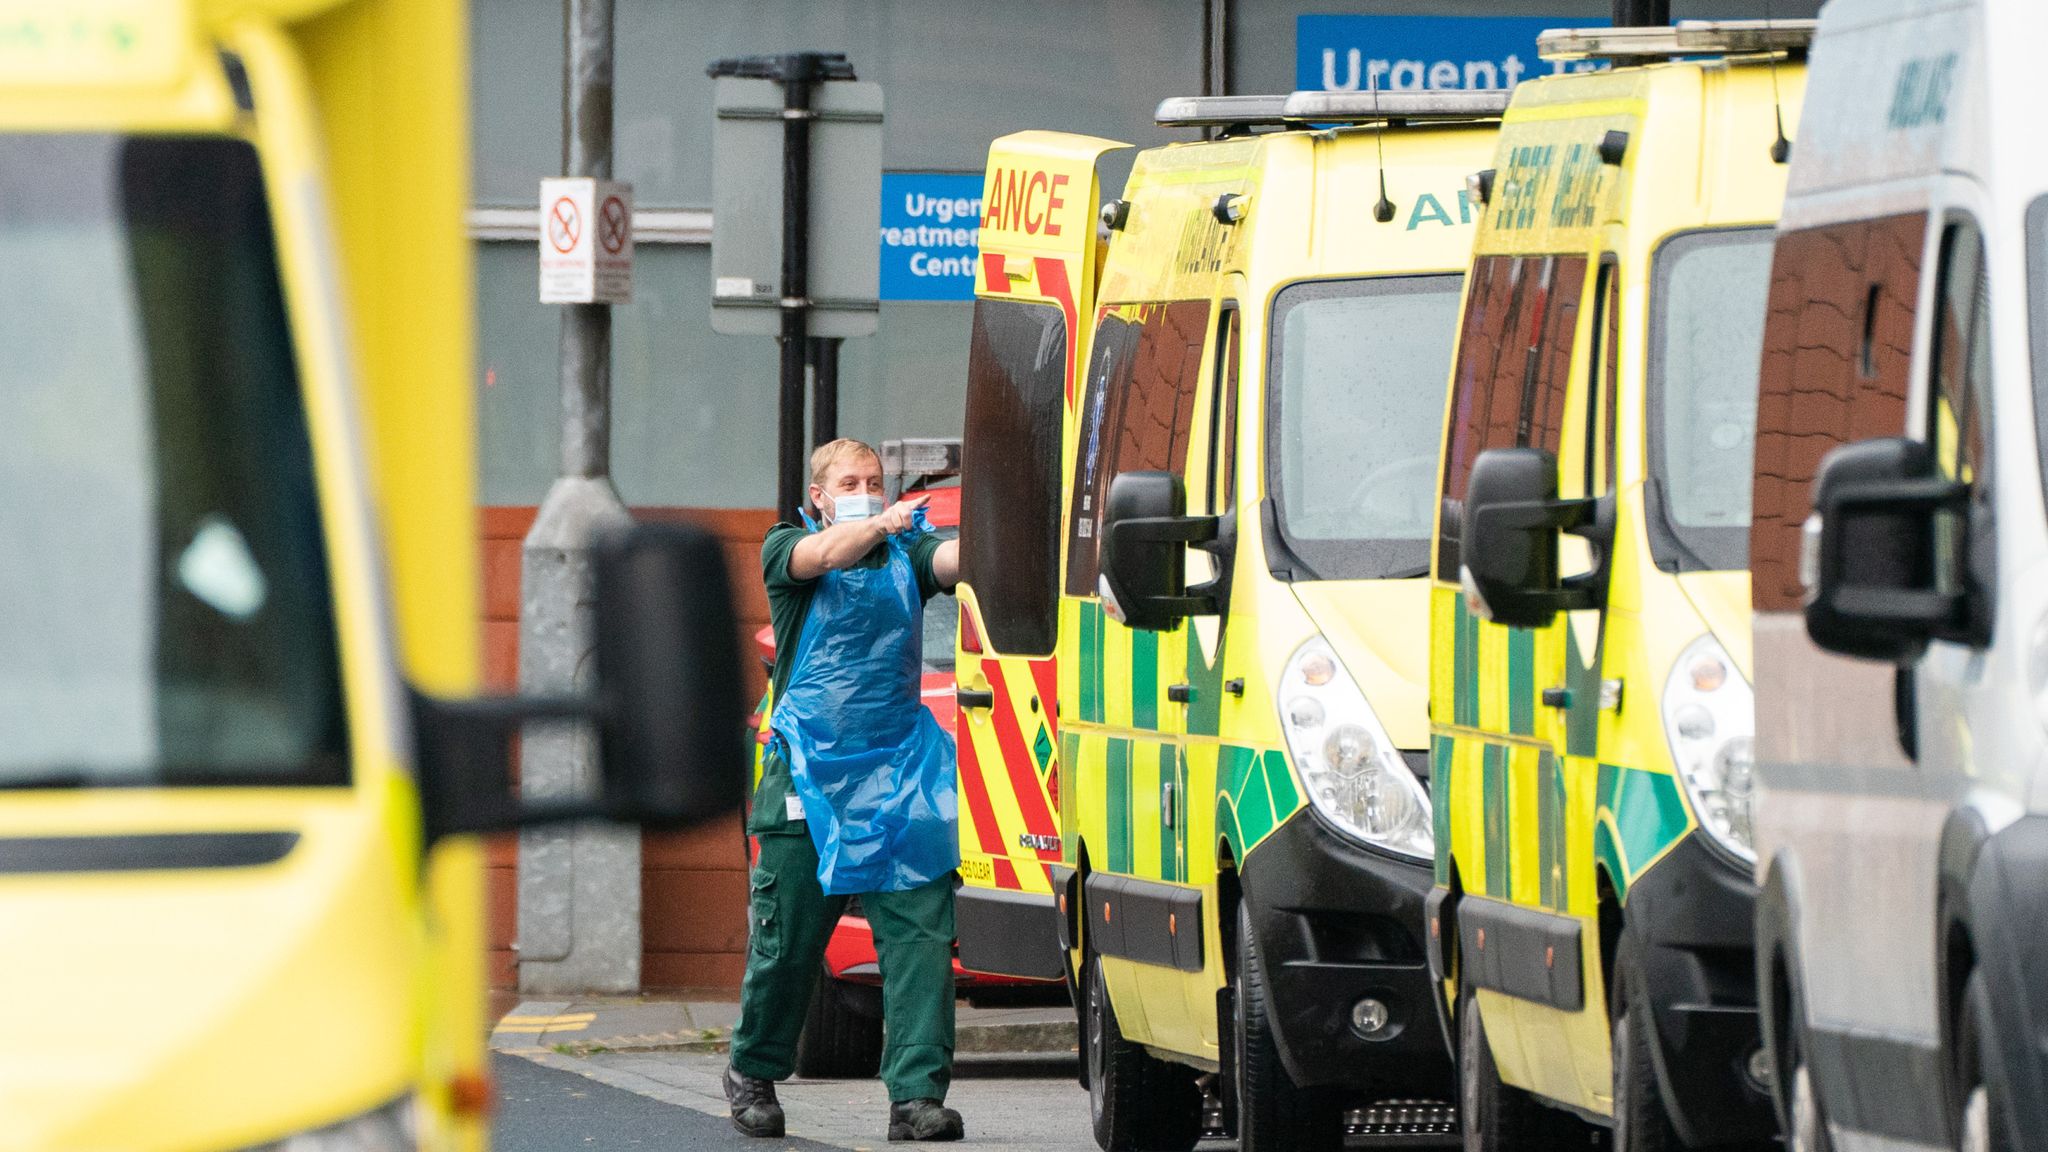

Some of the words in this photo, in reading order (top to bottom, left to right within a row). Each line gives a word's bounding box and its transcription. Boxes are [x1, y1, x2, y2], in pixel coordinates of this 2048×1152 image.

[1322, 47, 1525, 91] Urgent
[905, 192, 983, 223] Urgen
[980, 167, 1070, 236] ANCE
[880, 225, 980, 247] reatmen
[909, 251, 978, 276] Centr
